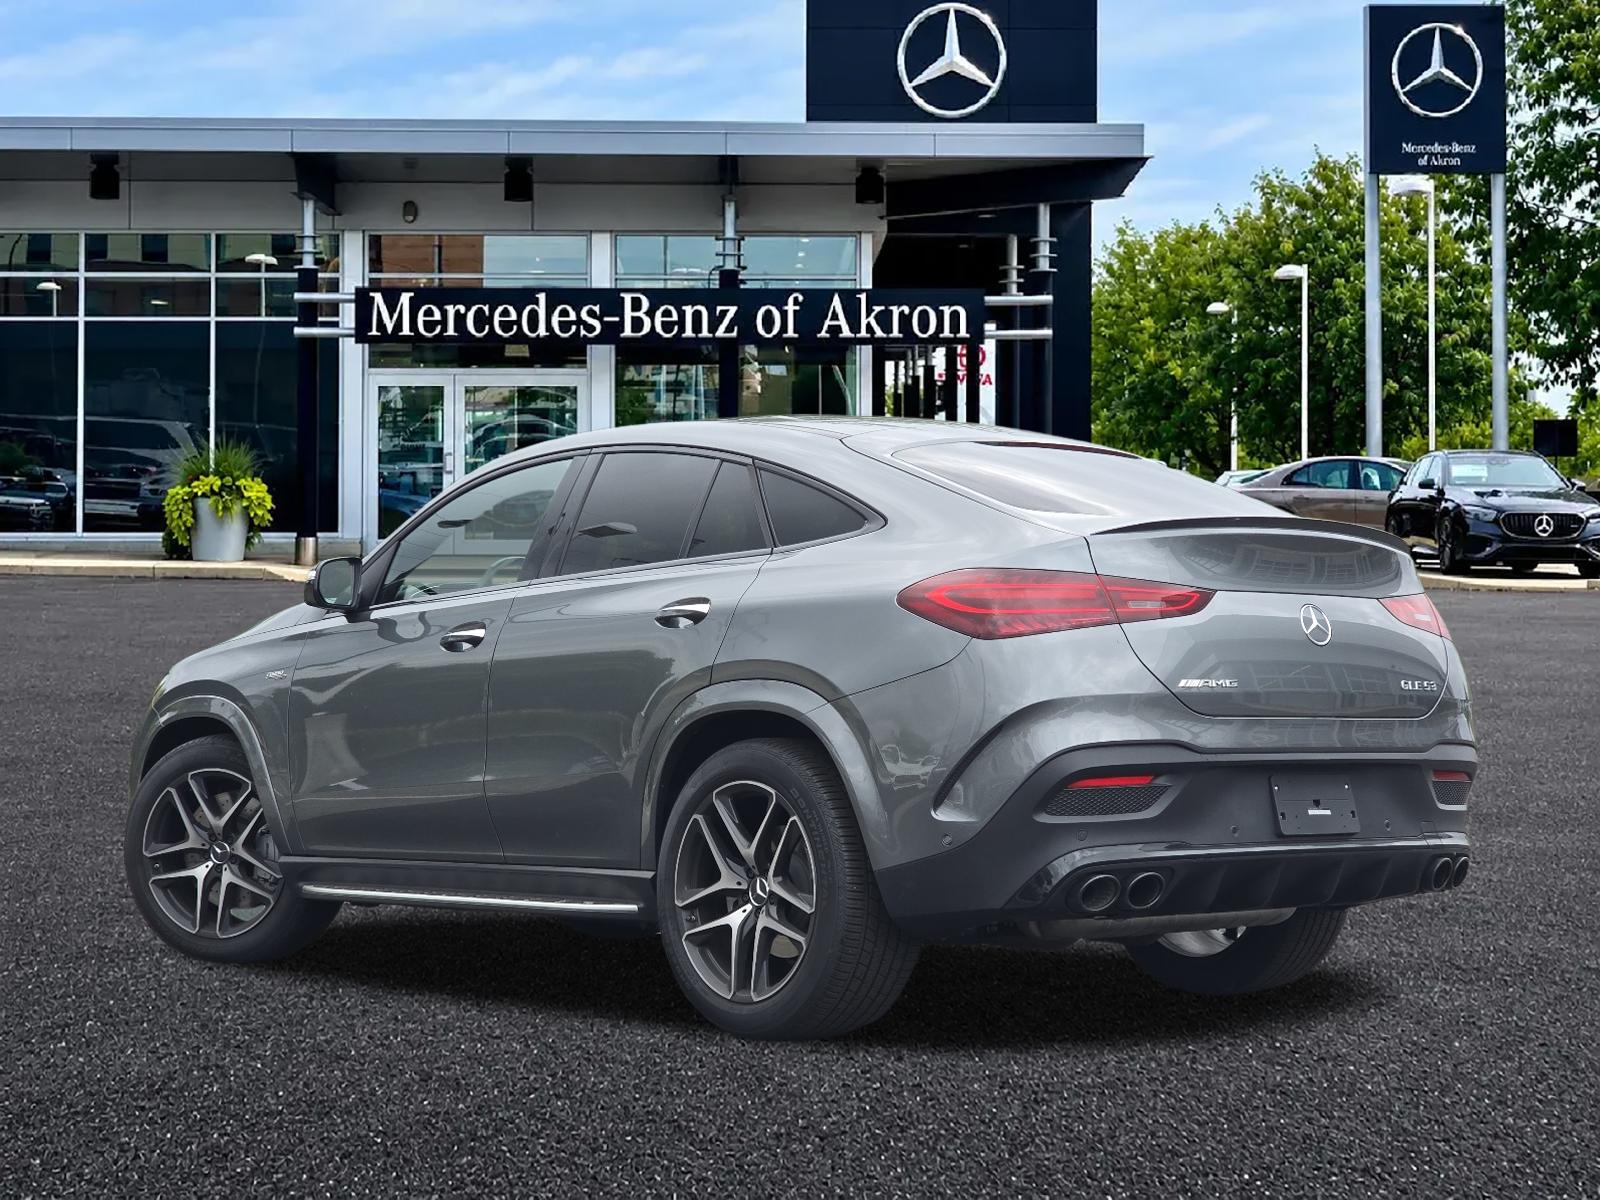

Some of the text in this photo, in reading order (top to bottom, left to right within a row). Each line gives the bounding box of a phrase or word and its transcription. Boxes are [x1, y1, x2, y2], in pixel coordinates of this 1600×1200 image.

[1401, 142, 1476, 154] Mercedes-Benz
[1417, 154, 1461, 166] of Akron
[367, 291, 971, 339] Mercedes-Benz of Akron
[1198, 679, 1239, 688] AMG
